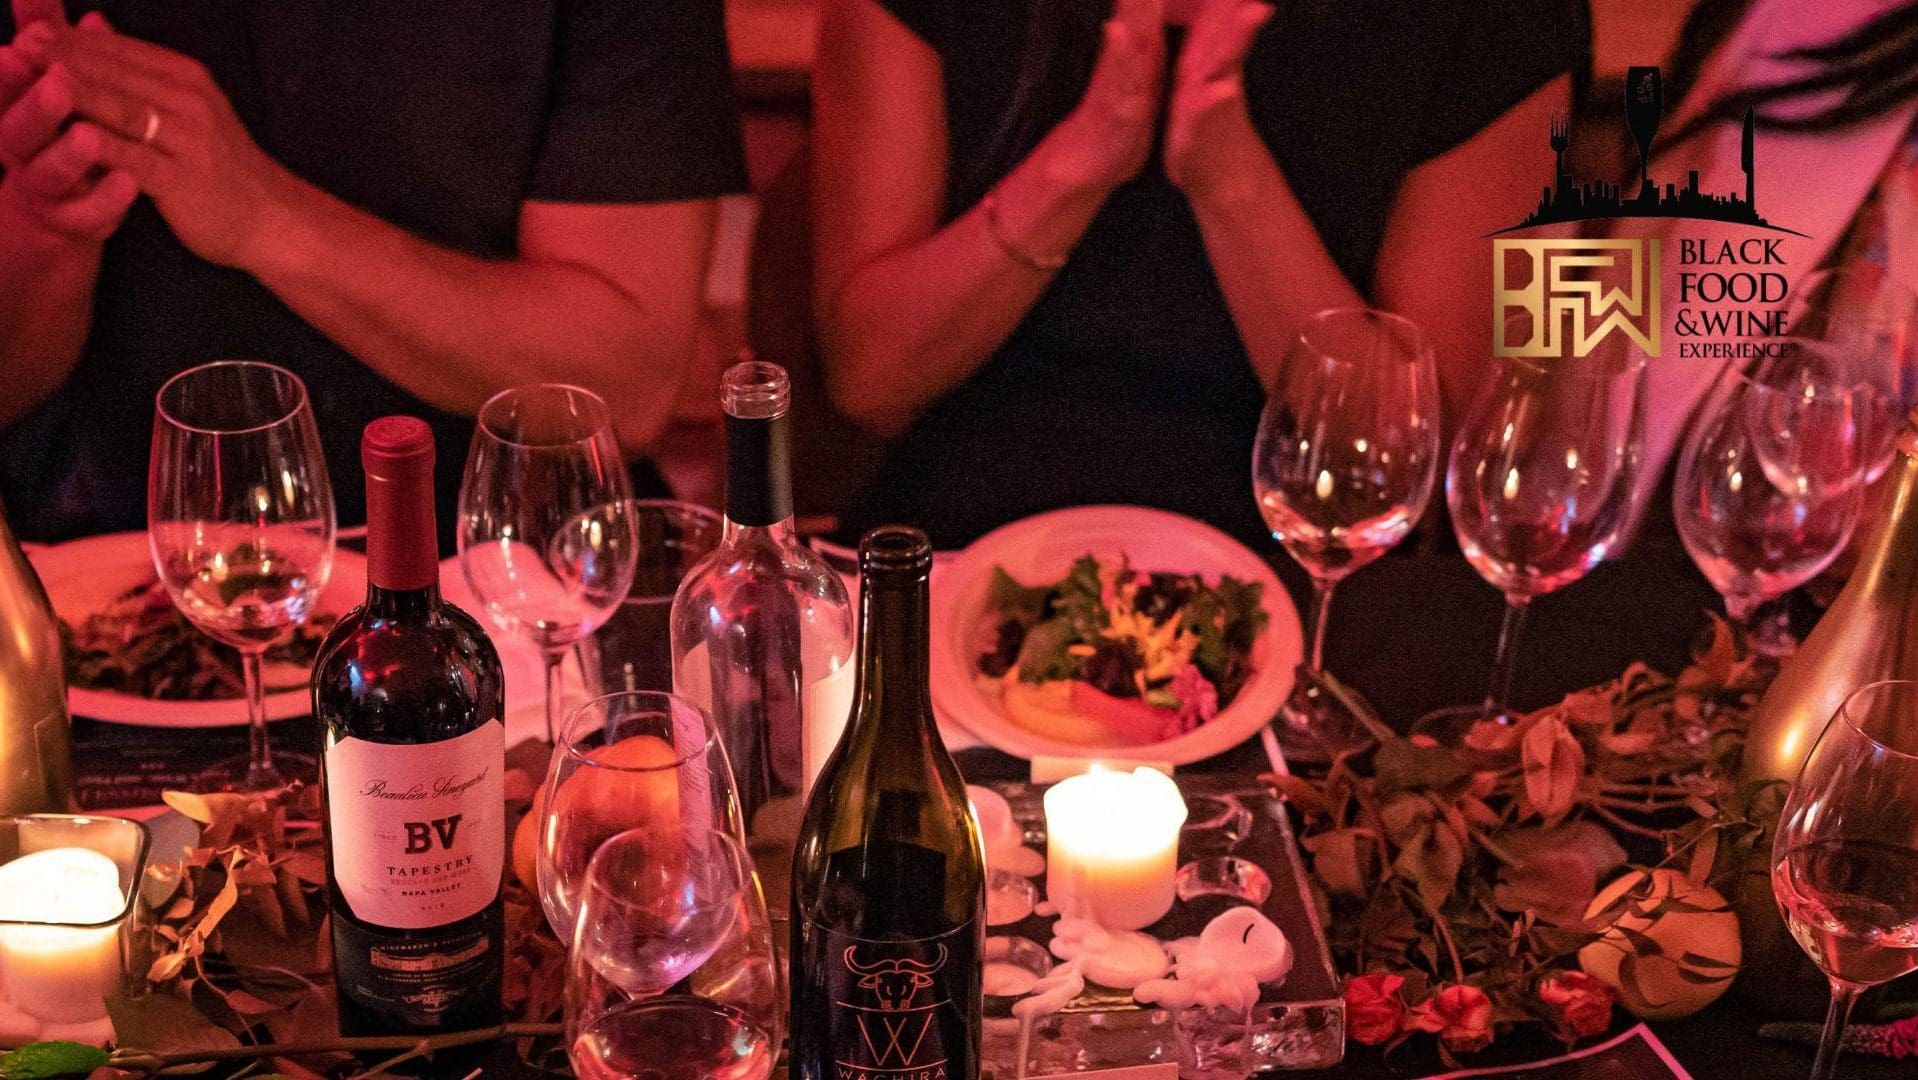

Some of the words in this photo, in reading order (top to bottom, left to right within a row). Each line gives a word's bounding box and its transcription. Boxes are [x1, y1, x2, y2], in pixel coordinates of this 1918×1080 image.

[360, 779, 428, 800] Beaulieu
[432, 765, 489, 800] Vineyard
[404, 813, 463, 854] BV
[387, 855, 474, 877] TAPESTRY
[856, 1012, 934, 1067] W
